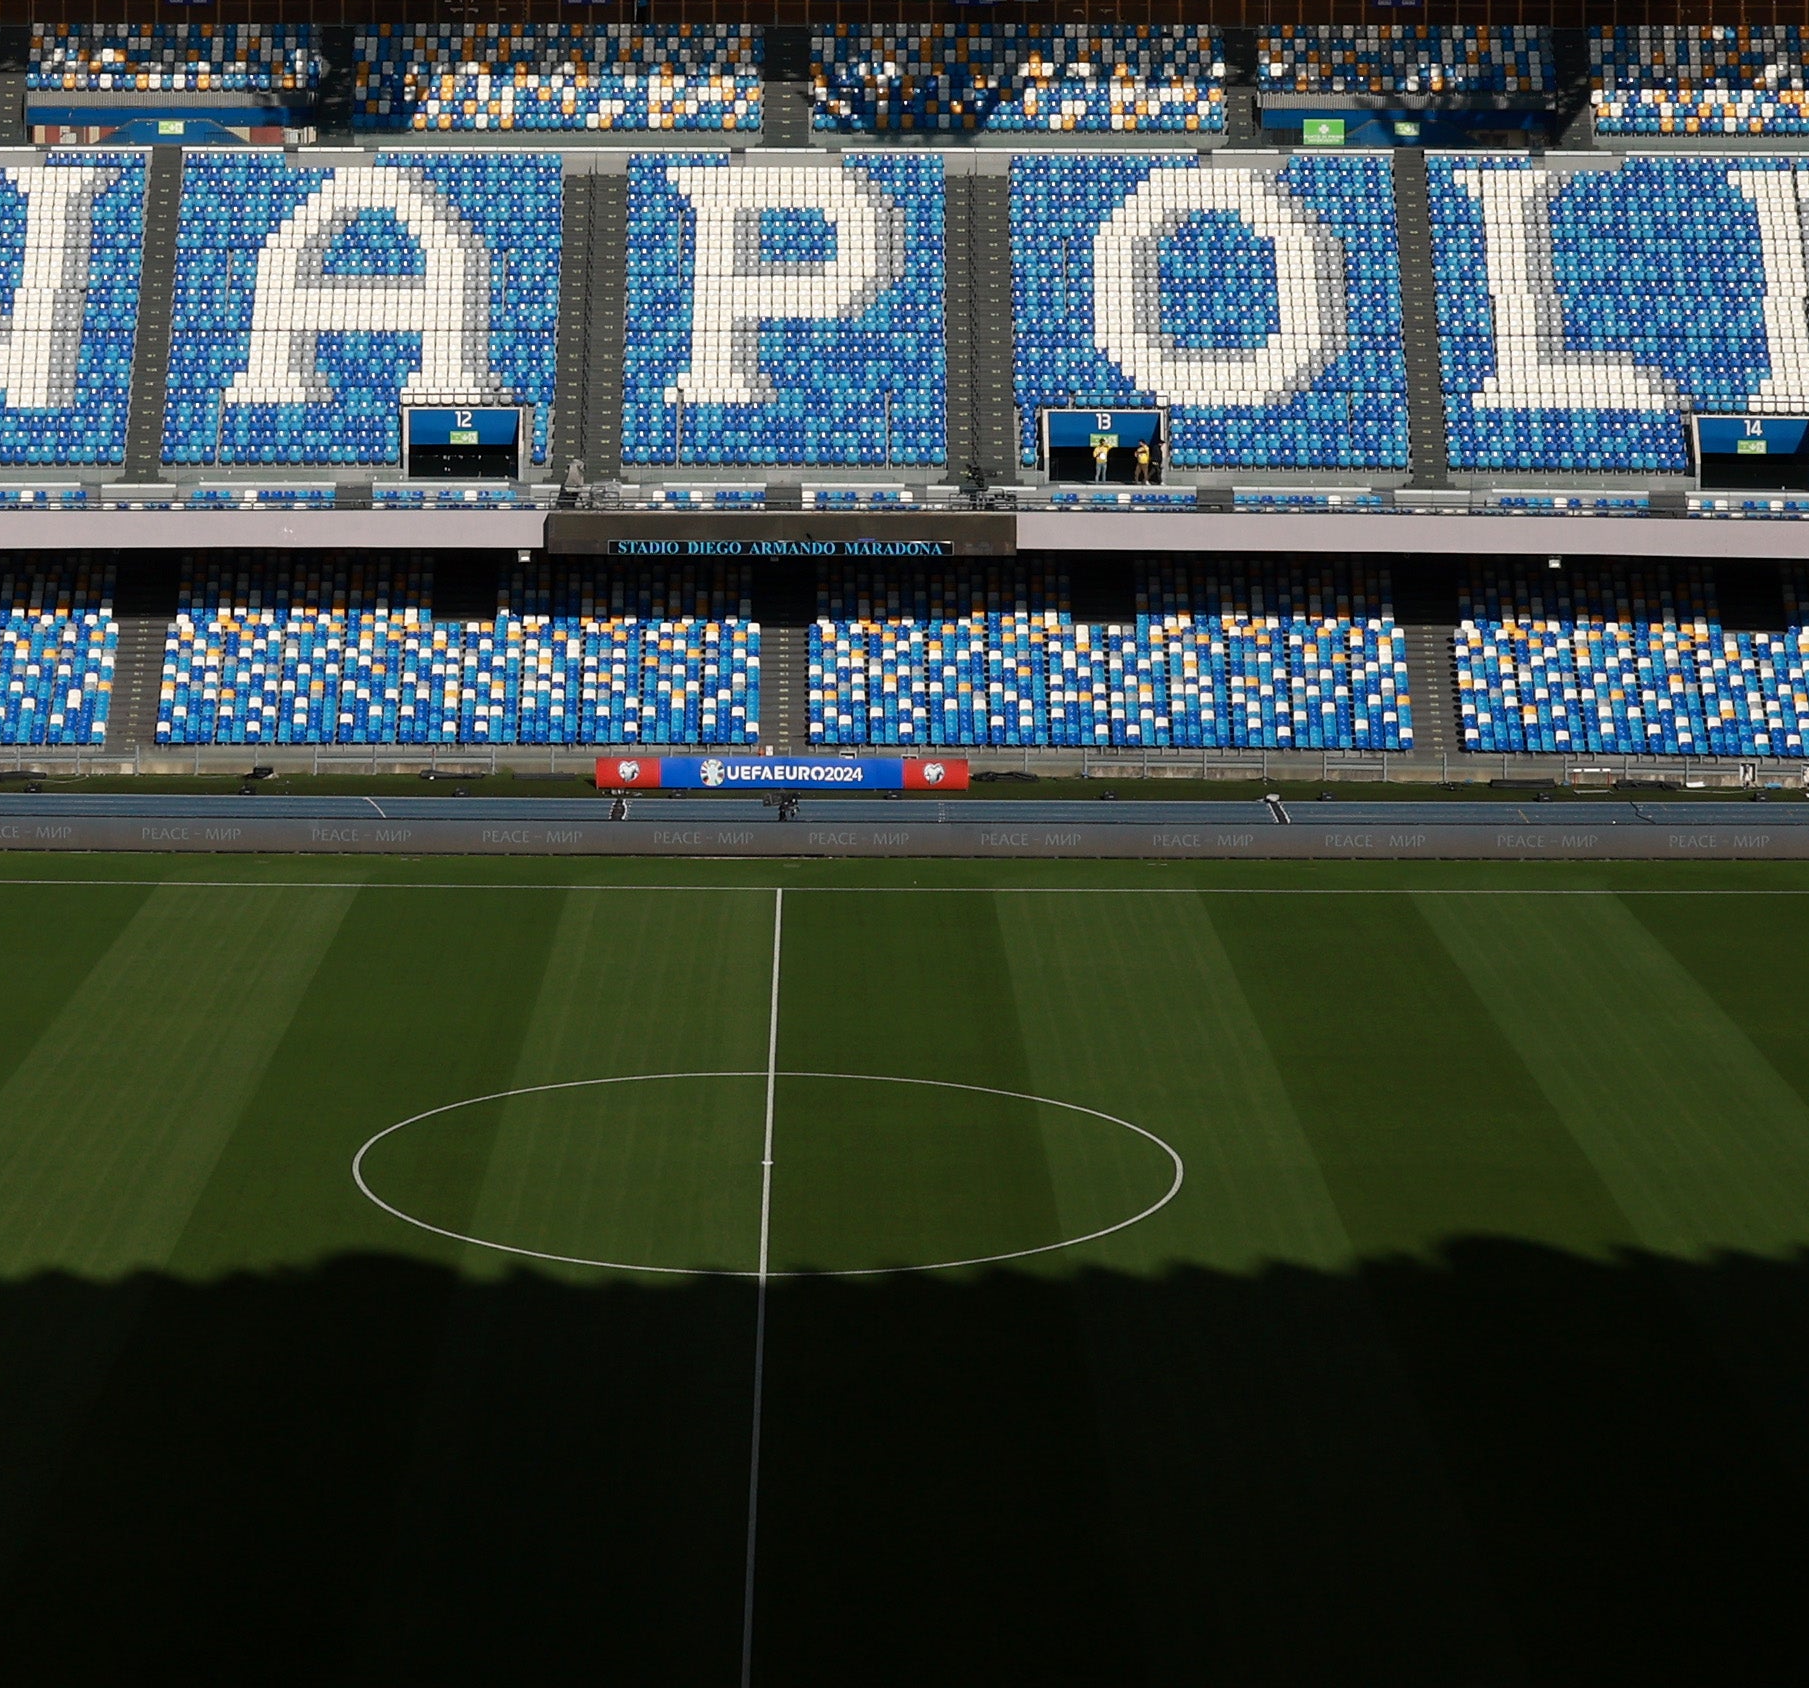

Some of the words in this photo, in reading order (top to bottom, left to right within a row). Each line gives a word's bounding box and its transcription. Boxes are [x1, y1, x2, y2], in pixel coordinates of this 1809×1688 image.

[455, 411, 472, 427] 12
[1096, 414, 1111, 430] 13
[1744, 419, 1762, 436] 14
[617, 542, 679, 555] STADIO
[688, 542, 742, 555] DIEGO
[748, 542, 836, 555] ARMANDO
[844, 542, 942, 555] MARADONA
[142, 827, 189, 840] PEACE
[311, 829, 359, 842] PEACE
[483, 830, 529, 843] PEACE
[654, 831, 701, 844] PEACE
[810, 832, 857, 845] PEACE
[981, 833, 1029, 846] PEACE
[1153, 834, 1201, 848] PEACE
[1325, 834, 1373, 847] PEACE
[1497, 834, 1545, 848] PEACE
[1669, 835, 1717, 848] PEACE
